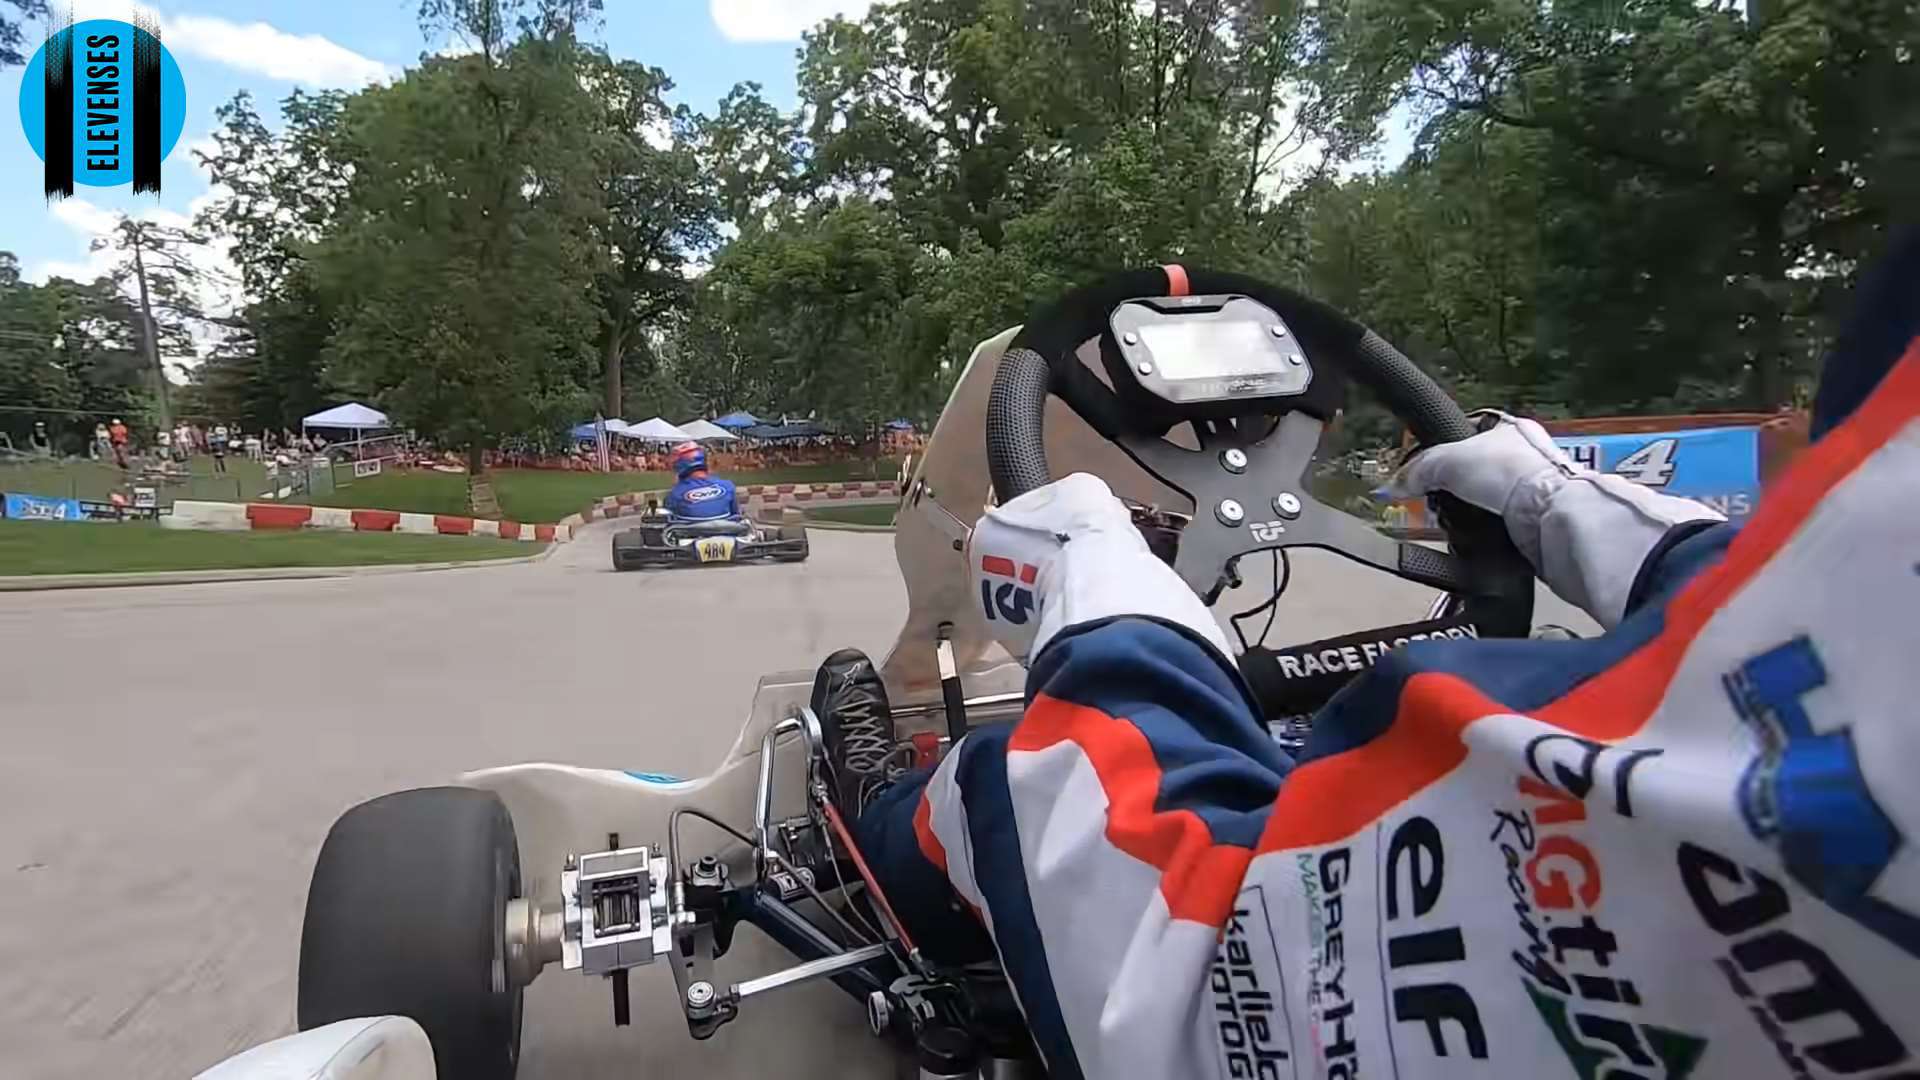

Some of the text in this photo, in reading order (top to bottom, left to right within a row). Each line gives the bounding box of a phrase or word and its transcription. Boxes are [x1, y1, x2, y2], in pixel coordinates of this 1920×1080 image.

[1615, 438, 1679, 487] 4
[1277, 646, 1364, 679] RACE
[1386, 816, 1489, 1060] elf
[1490, 808, 1573, 995] Racing
